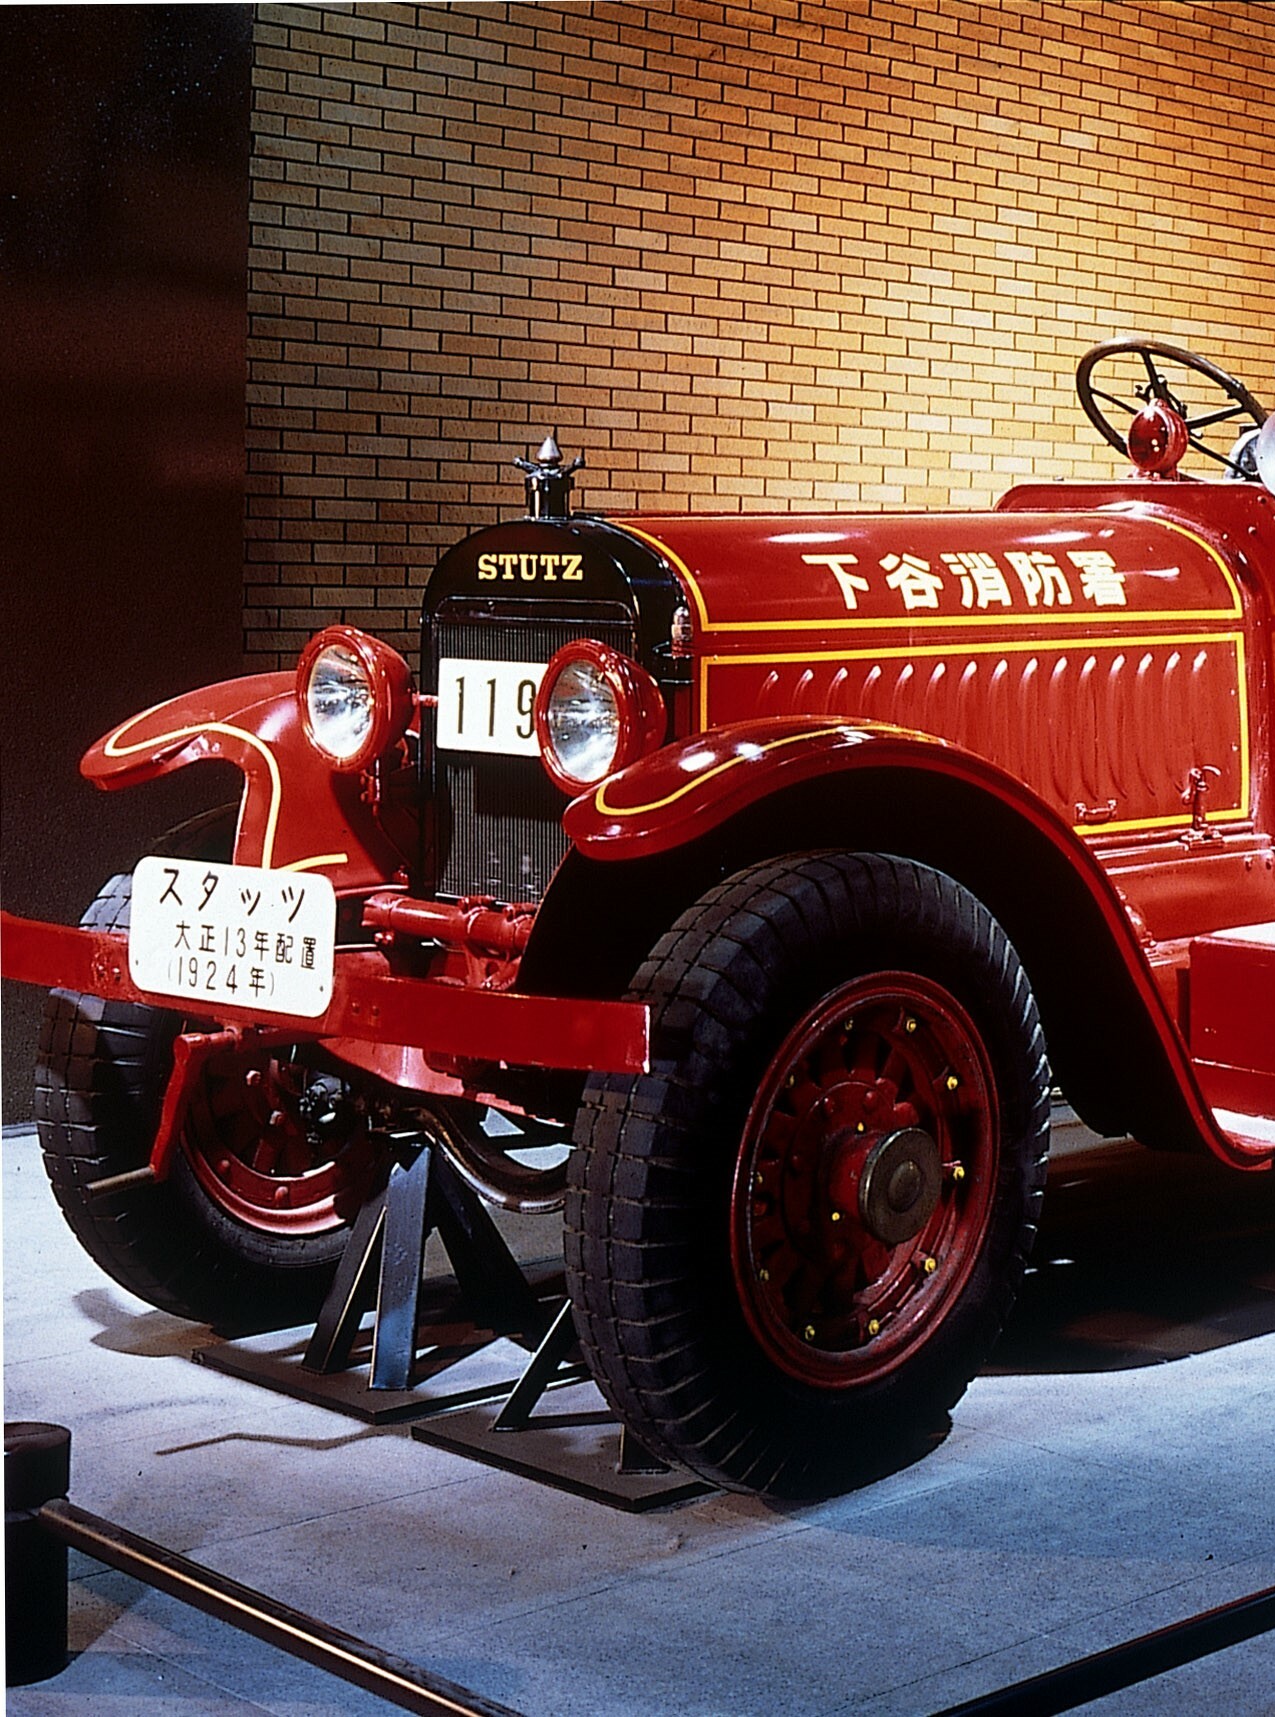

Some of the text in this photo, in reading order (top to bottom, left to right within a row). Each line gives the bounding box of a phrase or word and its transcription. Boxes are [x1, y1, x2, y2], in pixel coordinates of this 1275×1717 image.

[477, 553, 584, 581] STUTZ
[800, 550, 1127, 610] 下谷消防署
[455, 676, 537, 739] 119
[159, 867, 305, 923] スタッツ
[174, 920, 317, 970] 大正13年配置
[167, 956, 275, 998] (1924年)
